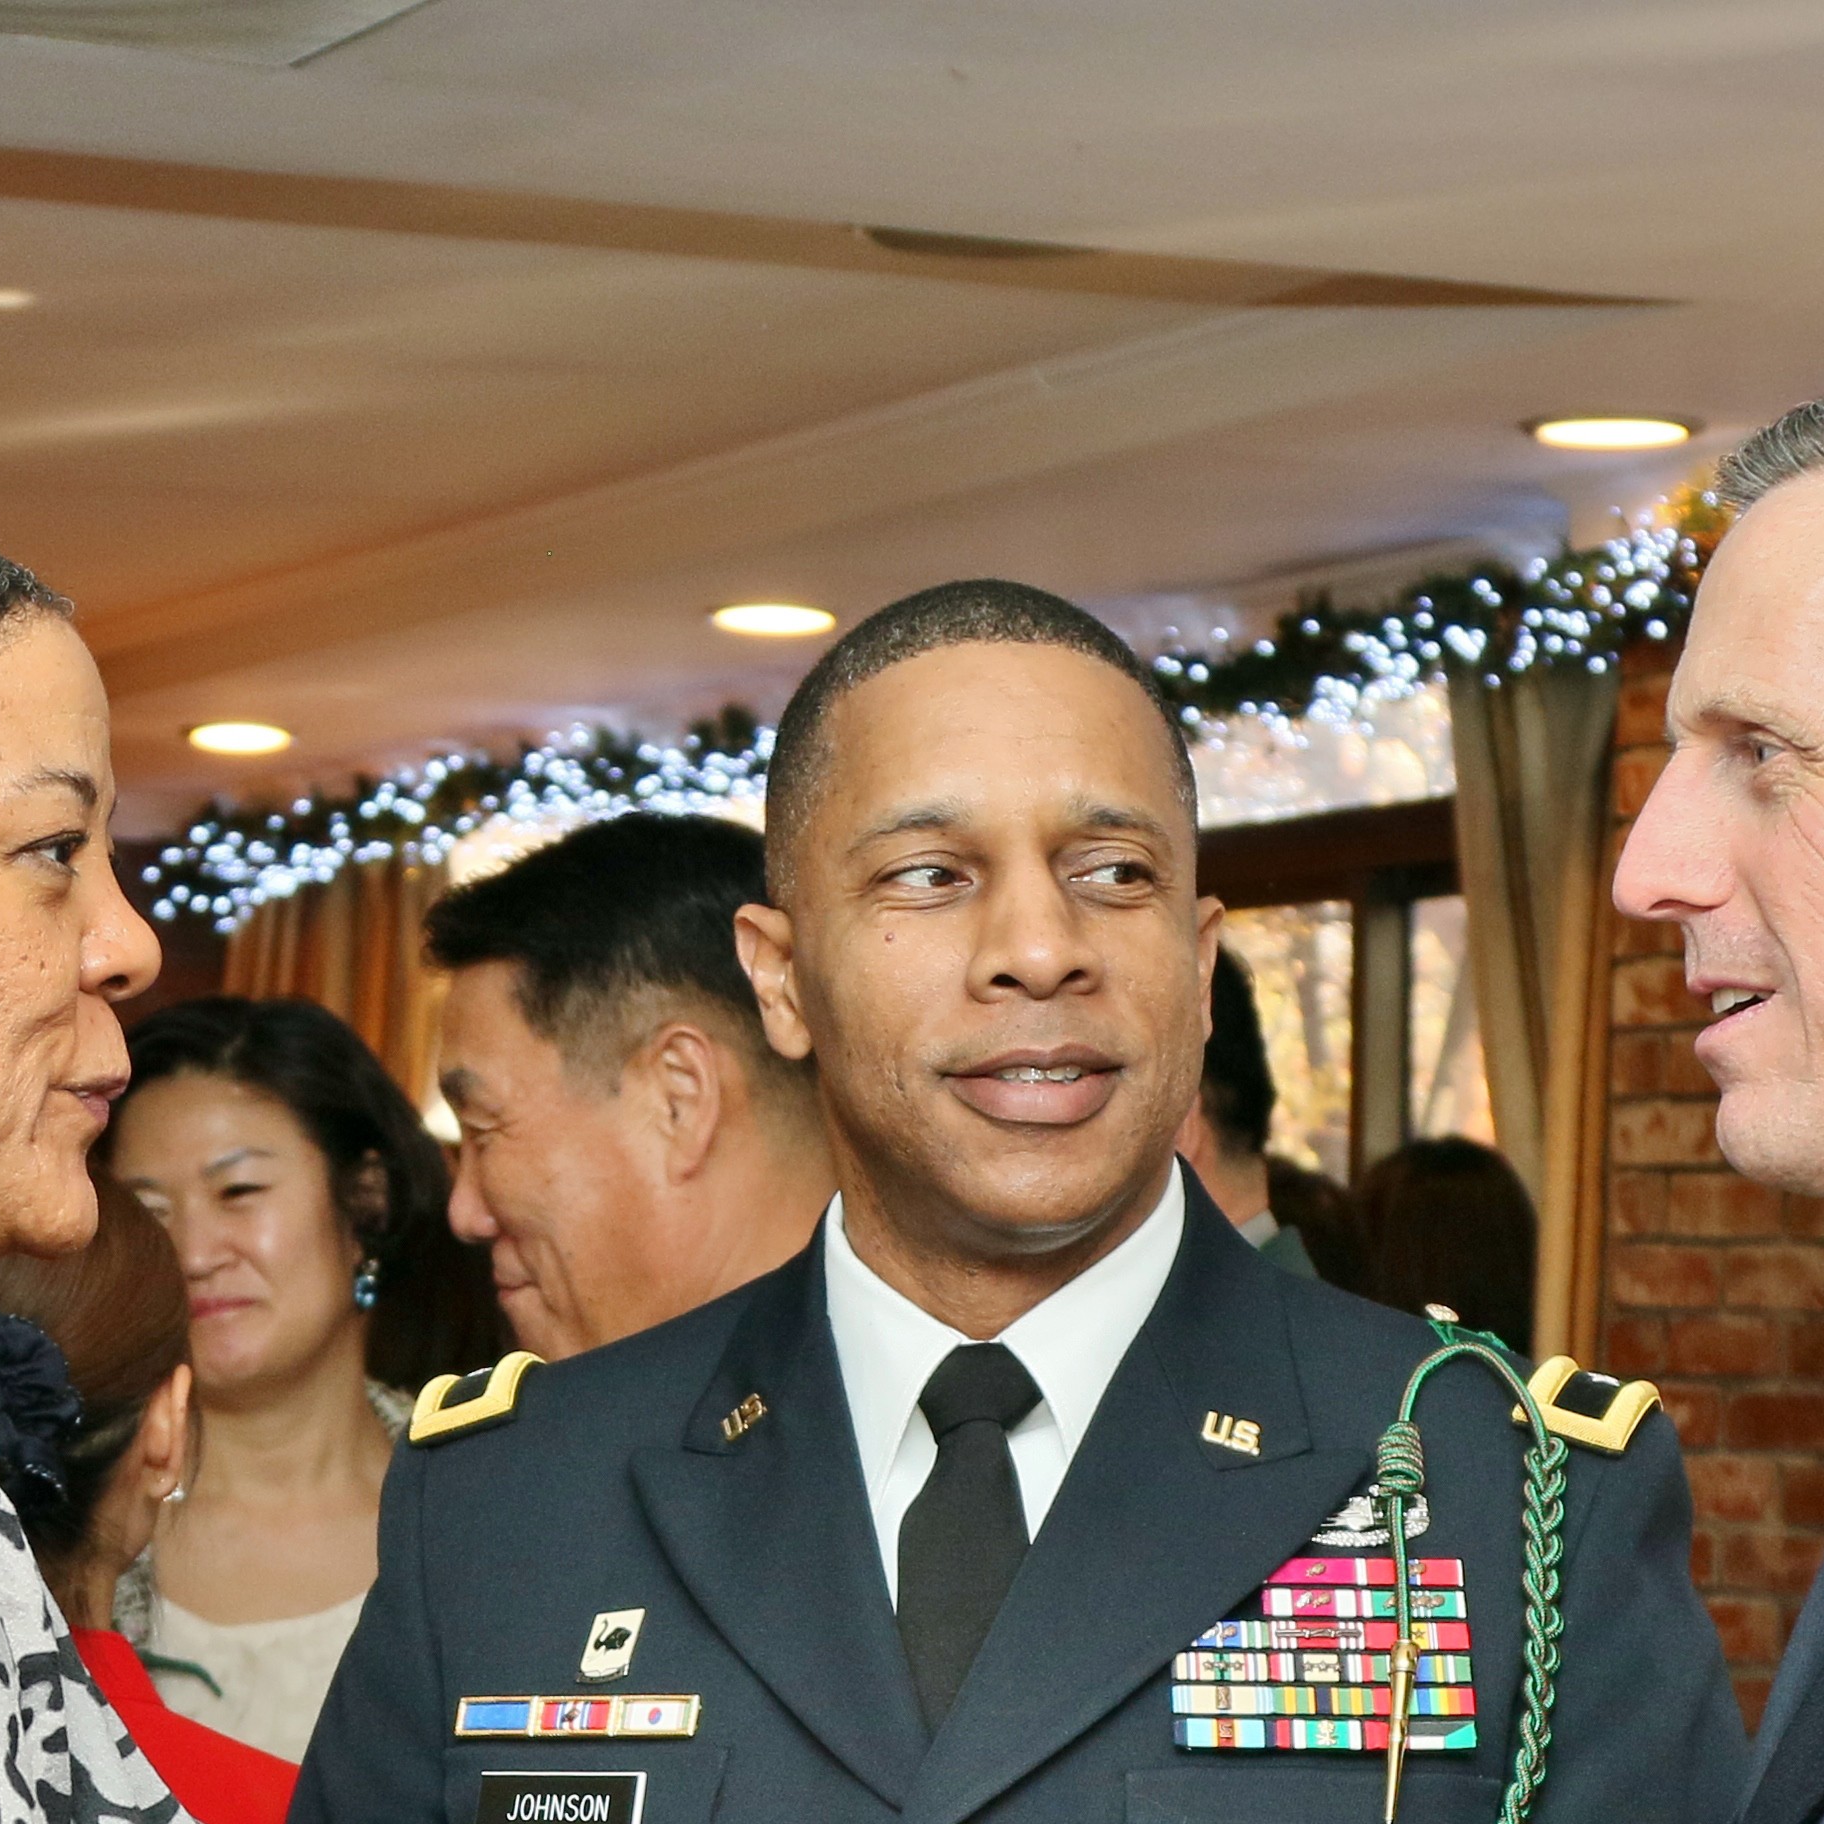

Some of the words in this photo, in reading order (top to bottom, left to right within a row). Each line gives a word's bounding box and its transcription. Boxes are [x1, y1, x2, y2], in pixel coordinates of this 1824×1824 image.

[720, 1392, 768, 1441] U.S.
[1201, 1410, 1261, 1456] U.S.
[506, 1793, 611, 1822] JOHNSON
